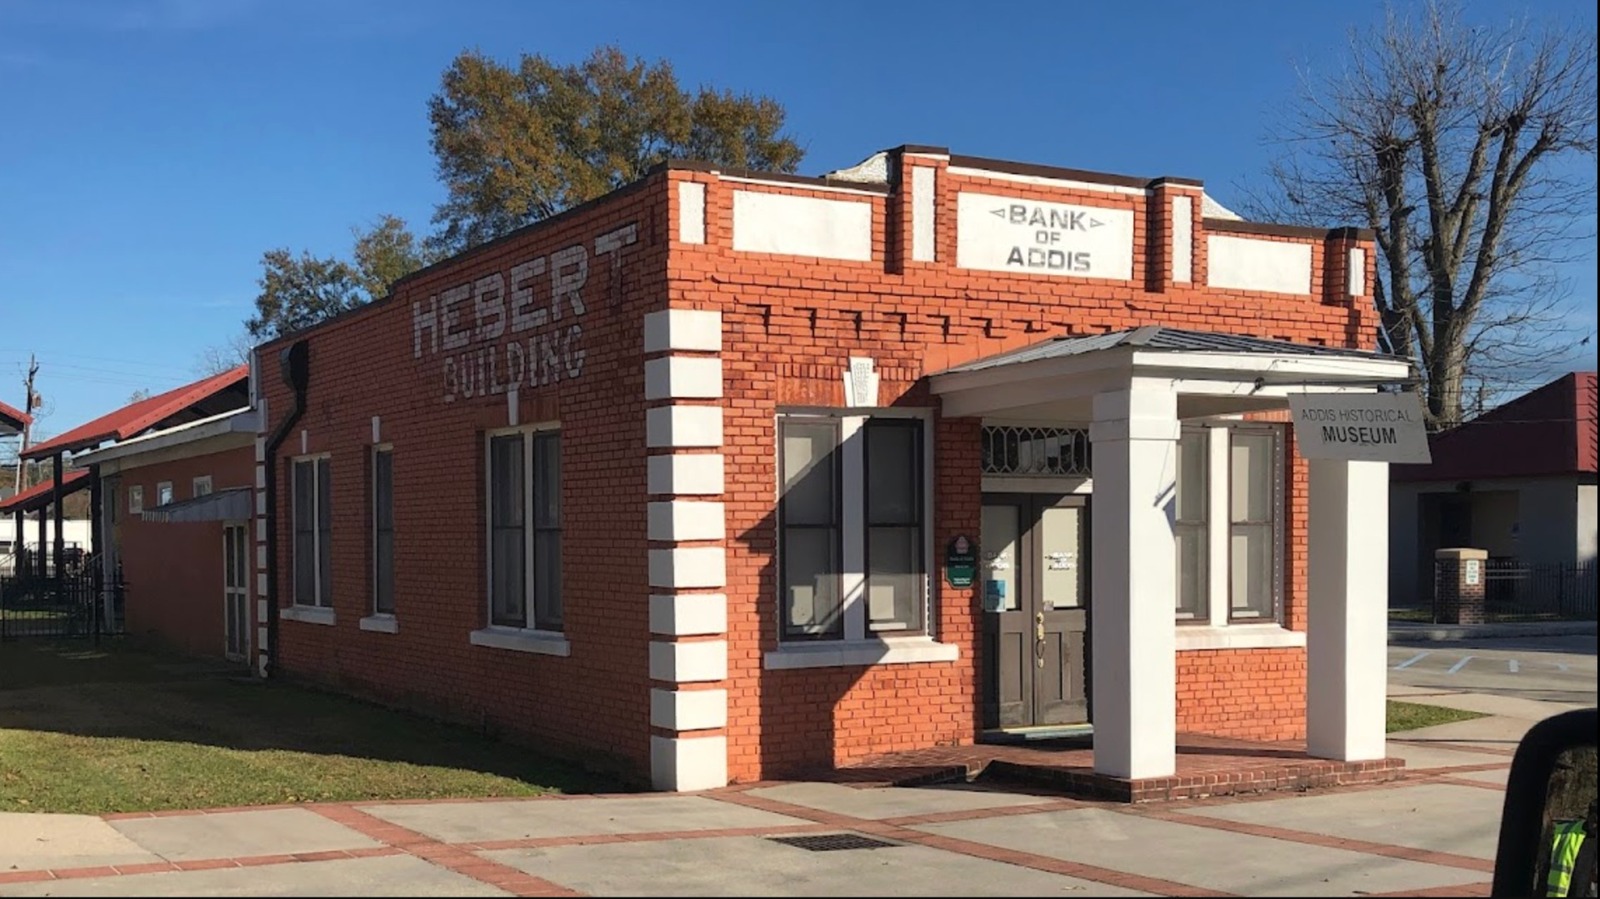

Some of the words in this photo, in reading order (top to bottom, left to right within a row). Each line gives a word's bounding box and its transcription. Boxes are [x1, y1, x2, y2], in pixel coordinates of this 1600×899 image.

[1009, 204, 1087, 232] BANK
[1035, 230, 1061, 245] OF
[1006, 246, 1091, 272] ADDIS
[412, 222, 638, 359] HEBERT
[443, 324, 587, 403] BUILDING
[1301, 408, 1336, 422] ADDIS
[1339, 408, 1414, 423] HISTORICAL
[1322, 425, 1398, 444] MUSEUM
